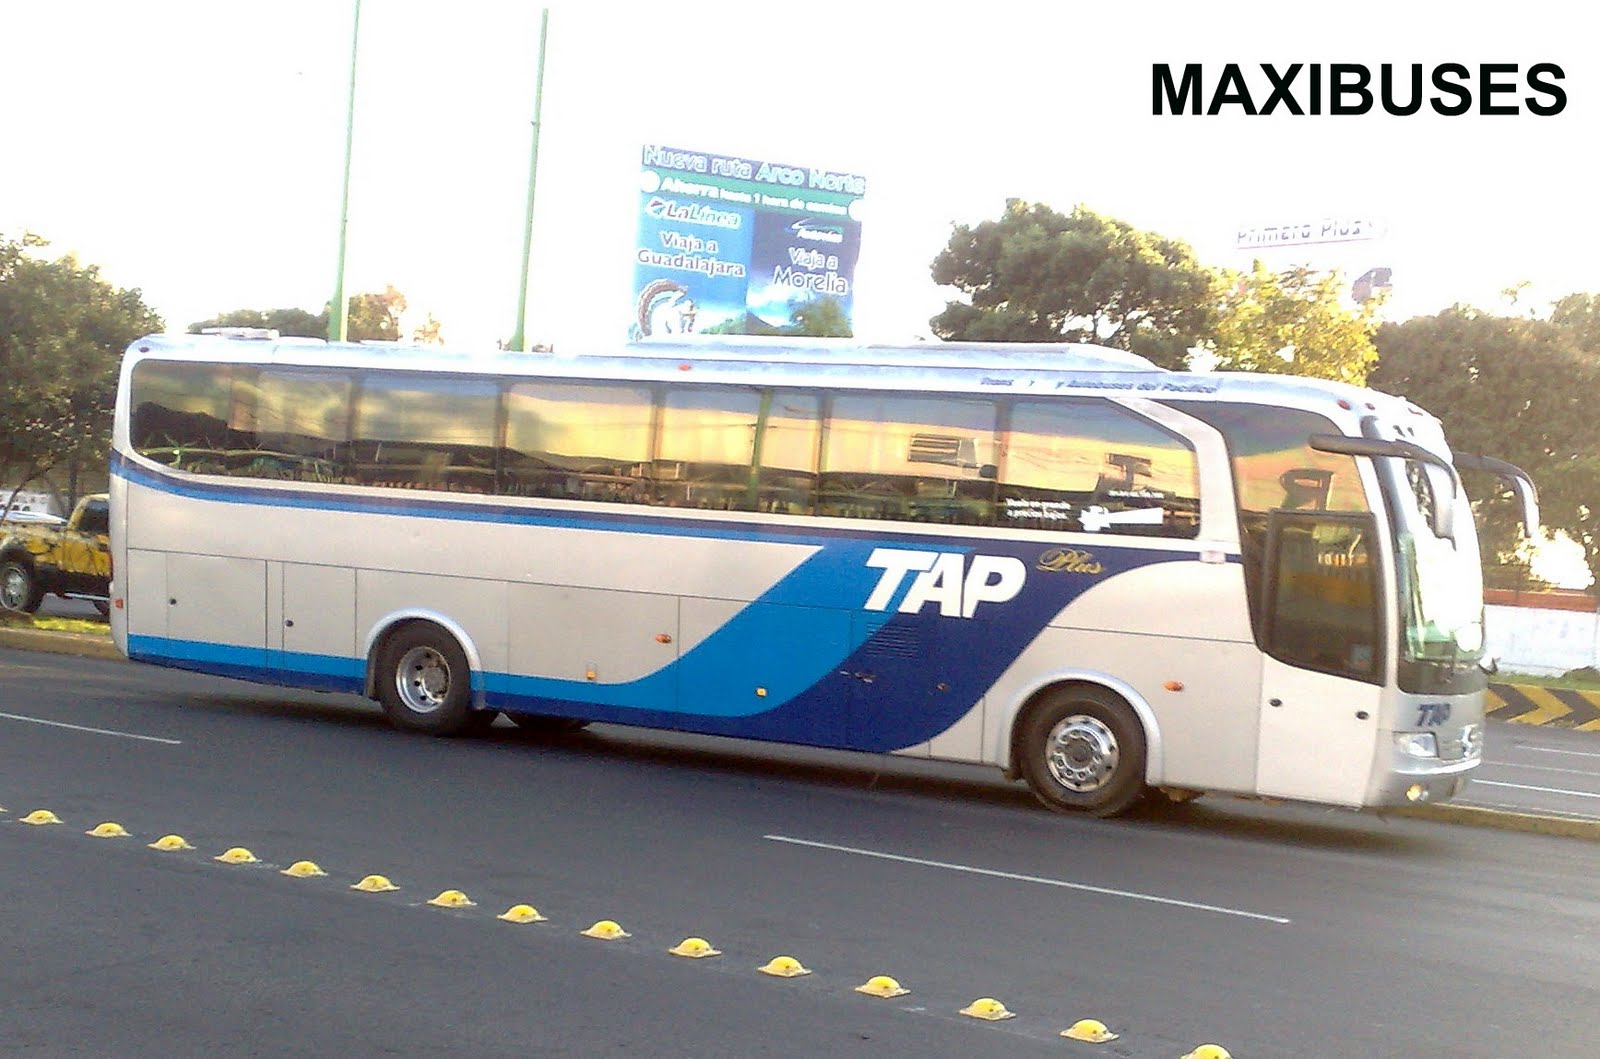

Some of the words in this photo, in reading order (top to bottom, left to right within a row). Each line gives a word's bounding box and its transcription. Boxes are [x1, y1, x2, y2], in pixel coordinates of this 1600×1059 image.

[643, 145, 707, 173] Nueva
[711, 157, 752, 179] ruta
[754, 162, 805, 186] Arco
[808, 167, 866, 195] Norte
[660, 230, 703, 251] Viaja
[707, 239, 718, 252] a
[637, 249, 745, 277] Guadalajara
[788, 247, 824, 271] Viaja
[825, 254, 839, 268] a
[773, 265, 848, 294] Morelia
[863, 547, 1028, 619] TAP
[1036, 547, 1105, 575] Plus
